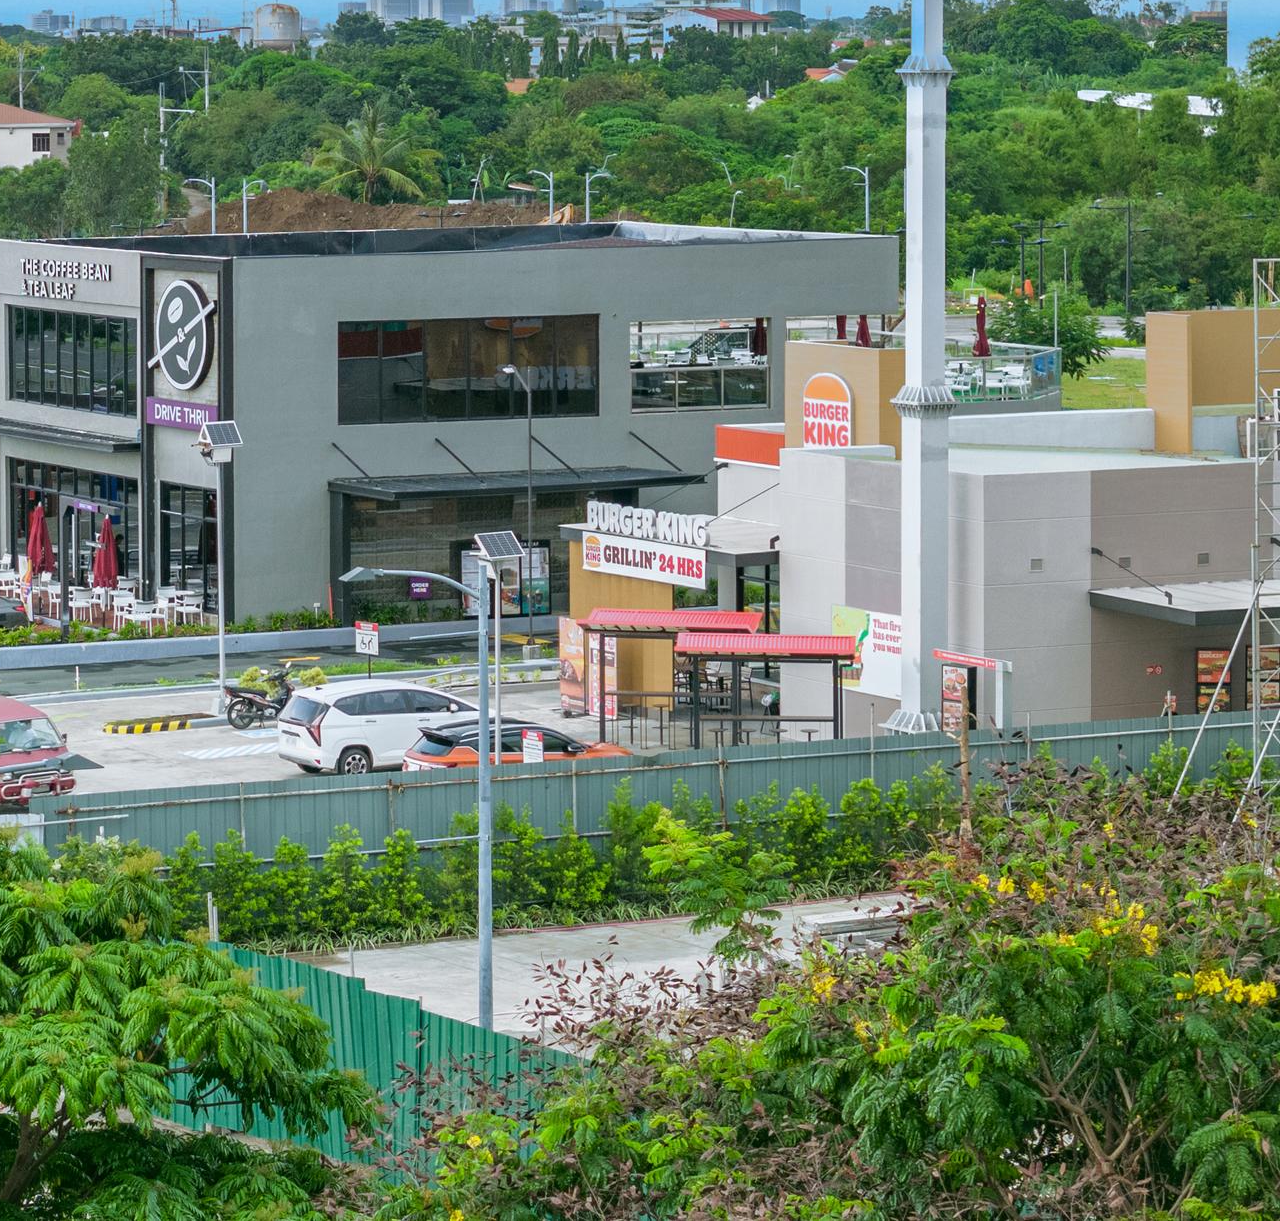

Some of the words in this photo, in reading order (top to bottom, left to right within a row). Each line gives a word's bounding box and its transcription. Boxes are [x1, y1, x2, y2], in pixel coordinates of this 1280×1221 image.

[20, 258, 40, 276] THE
[41, 259, 80, 279] COFFEE
[82, 263, 111, 282] BEAN
[29, 280, 49, 297] TEA
[50, 282, 75, 299] LEAF
[154, 403, 182, 423] DRIVE
[183, 407, 209, 426] THRU
[804, 401, 849, 422] BURGER
[804, 420, 849, 447] KING
[587, 500, 657, 539] BURGER
[658, 510, 710, 547] KING
[585, 544, 601, 553] BURGER
[585, 552, 601, 563] KING
[659, 553, 675, 574] 24
[677, 556, 703, 580] HRS
[873, 618, 889, 630] That
[889, 620, 902, 633] firs
[873, 630, 885, 641] has
[885, 633, 902, 643] ever
[873, 642, 886, 653] you
